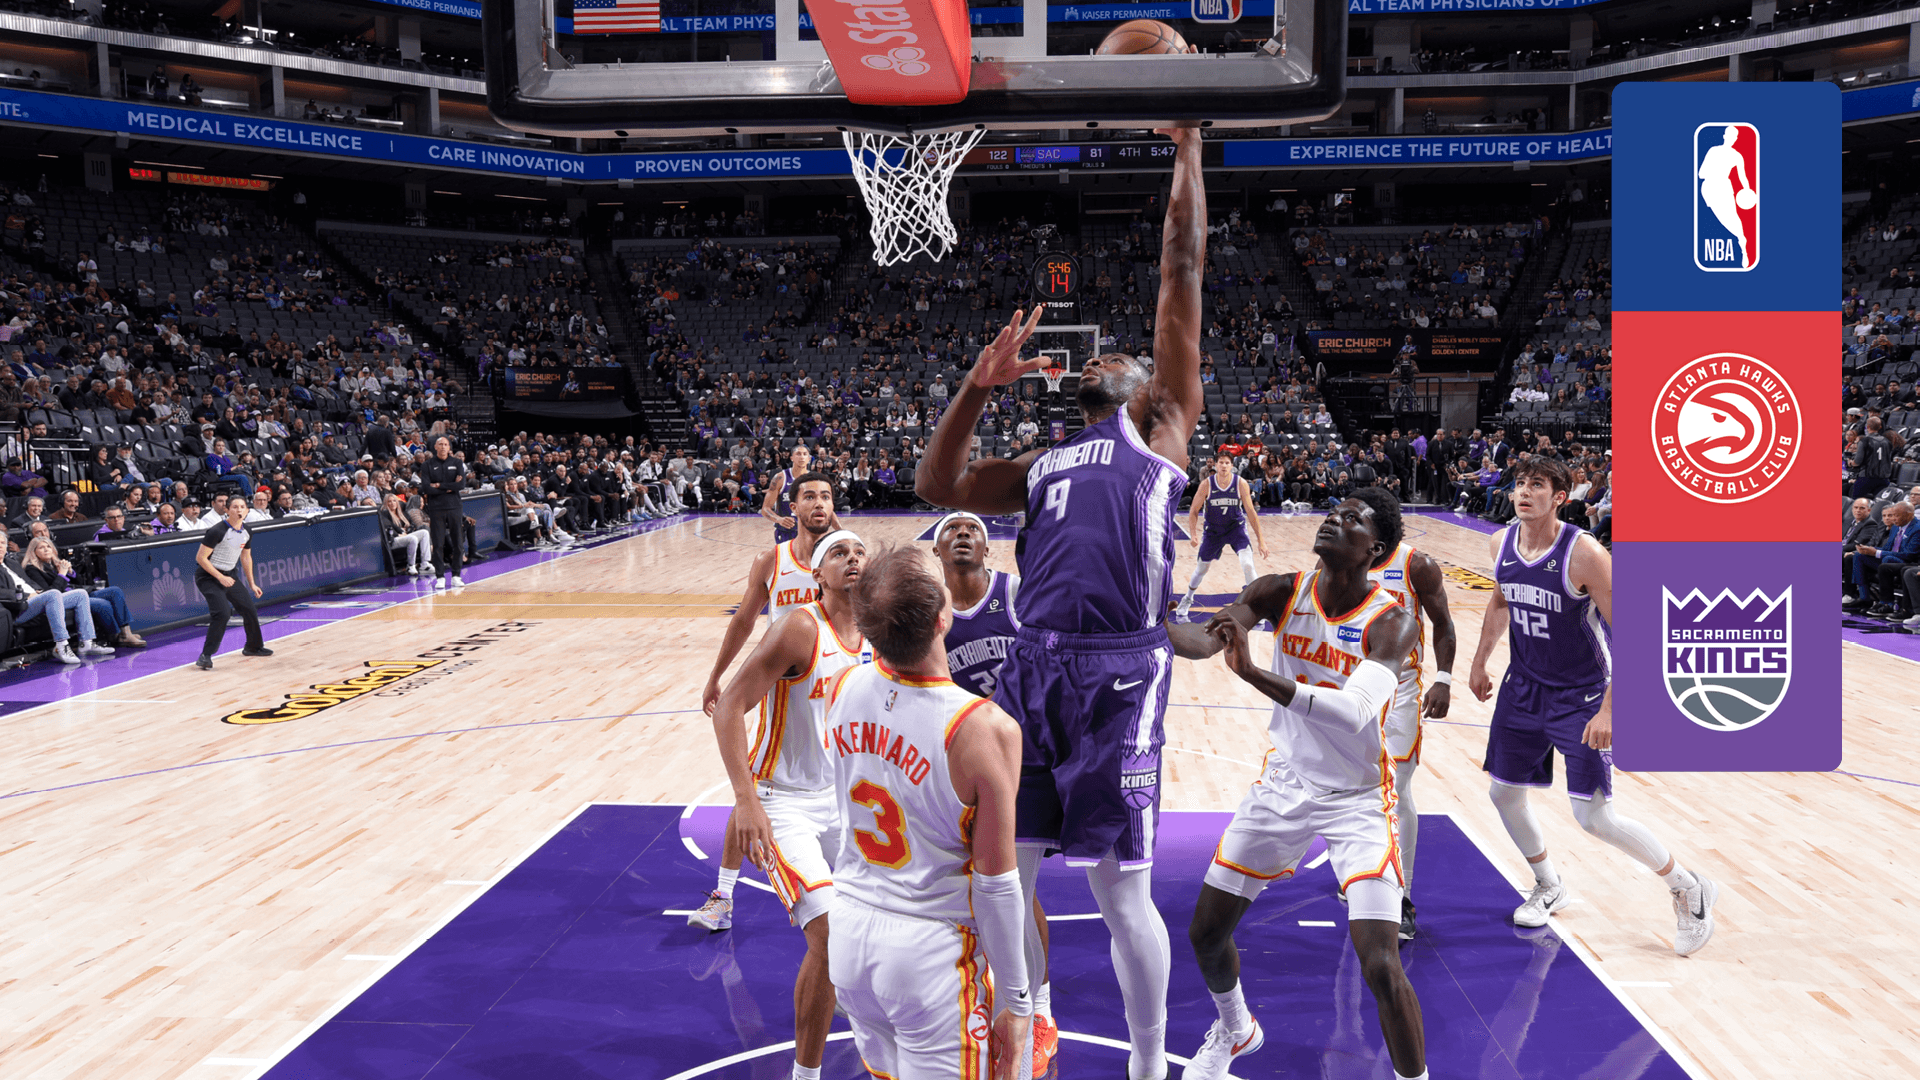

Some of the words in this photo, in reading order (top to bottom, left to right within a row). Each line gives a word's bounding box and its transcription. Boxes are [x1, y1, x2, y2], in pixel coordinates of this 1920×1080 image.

[1199, 0, 1223, 15] NBA
[1379, 0, 1425, 10] TEAM
[683, 17, 728, 31] TEAM
[733, 15, 775, 30] PHYS
[1082, 11, 1111, 20] KAISER
[1113, 9, 1171, 19] PERMANENTE
[127, 111, 228, 136] MEDICAL
[233, 123, 363, 150] EXCELLENCE
[989, 150, 1008, 160] 122
[1037, 149, 1061, 159] SAC
[1090, 148, 1102, 158] 81
[1118, 148, 1140, 156] 4TH
[1151, 146, 1176, 156] 5:47
[1290, 144, 1402, 159] EXPERIENCE
[1408, 143, 1443, 157] THE
[1449, 142, 1520, 156] FUTURE
[1526, 141, 1552, 155] OF
[428, 145, 476, 163] CARE
[481, 150, 585, 174] INNOVATION
[635, 159, 703, 173] PROVEN
[708, 157, 802, 171] OUTCOMES
[1048, 262, 1071, 273] 5:46
[1052, 274, 1069, 293] 14
[1318, 338, 1344, 348] ERIC
[1345, 338, 1392, 348] CHURCH
[1028, 439, 1115, 498] SACRAMENTO
[1046, 477, 1072, 522] 9
[1220, 506, 1228, 515] 7
[258, 546, 354, 588] PERMANENTE
[1500, 583, 1562, 613] SACRAMENTO
[1512, 606, 1550, 640] 42
[417, 622, 544, 658] CENTER
[1282, 633, 1362, 678] ATLANT
[832, 722, 931, 786] KENNARD
[1120, 772, 1157, 788] KINGS
[850, 778, 912, 870] 3
